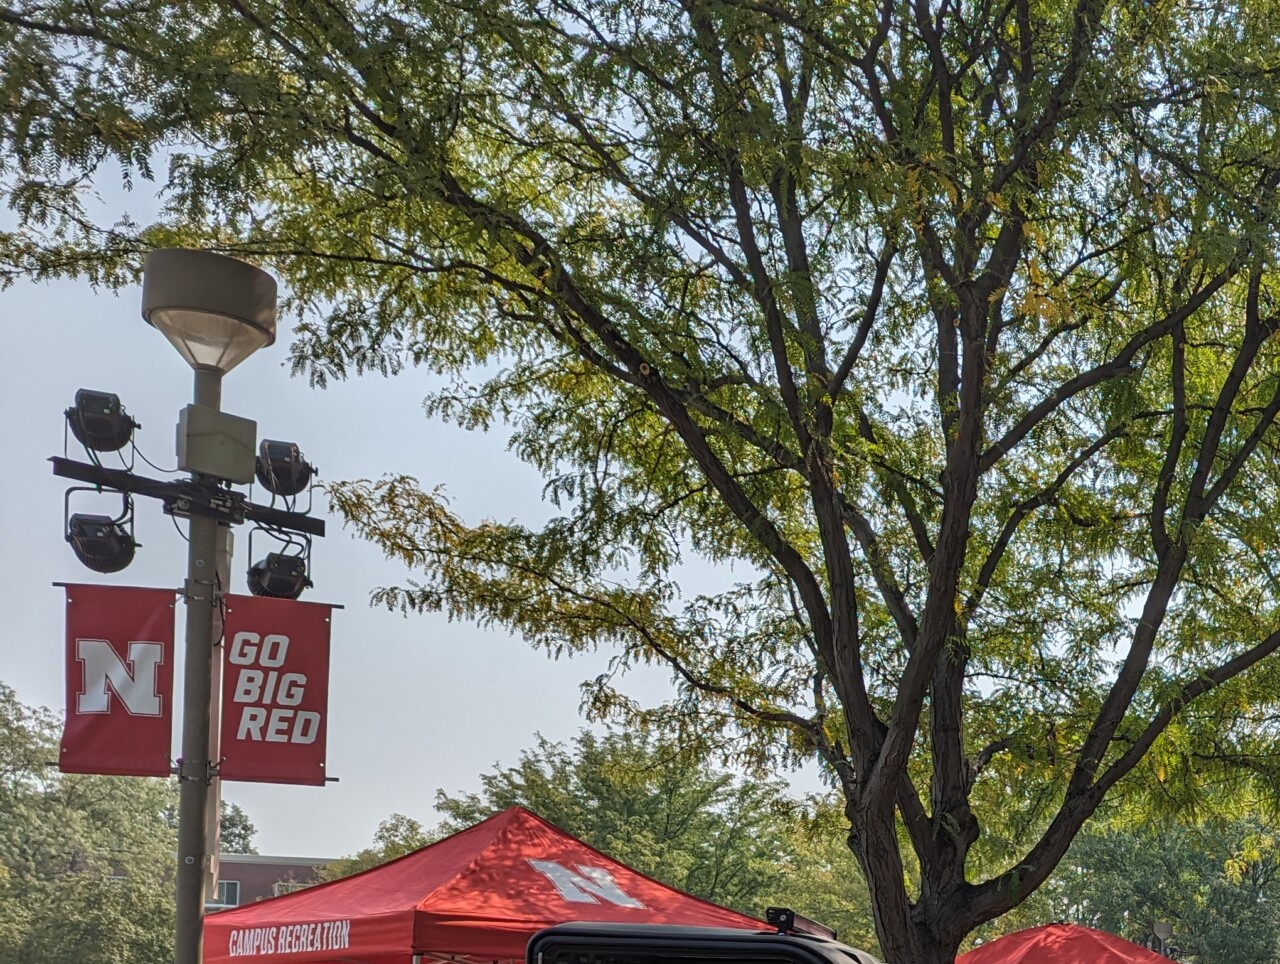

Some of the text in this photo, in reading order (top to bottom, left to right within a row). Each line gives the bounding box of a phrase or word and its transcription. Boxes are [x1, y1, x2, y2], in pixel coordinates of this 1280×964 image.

[229, 631, 290, 668] GO
[75, 638, 164, 717] N
[233, 668, 308, 706] BIG
[236, 706, 321, 744] RED
[525, 857, 648, 910] N
[228, 920, 351, 957] CAMPUS RECREATION
